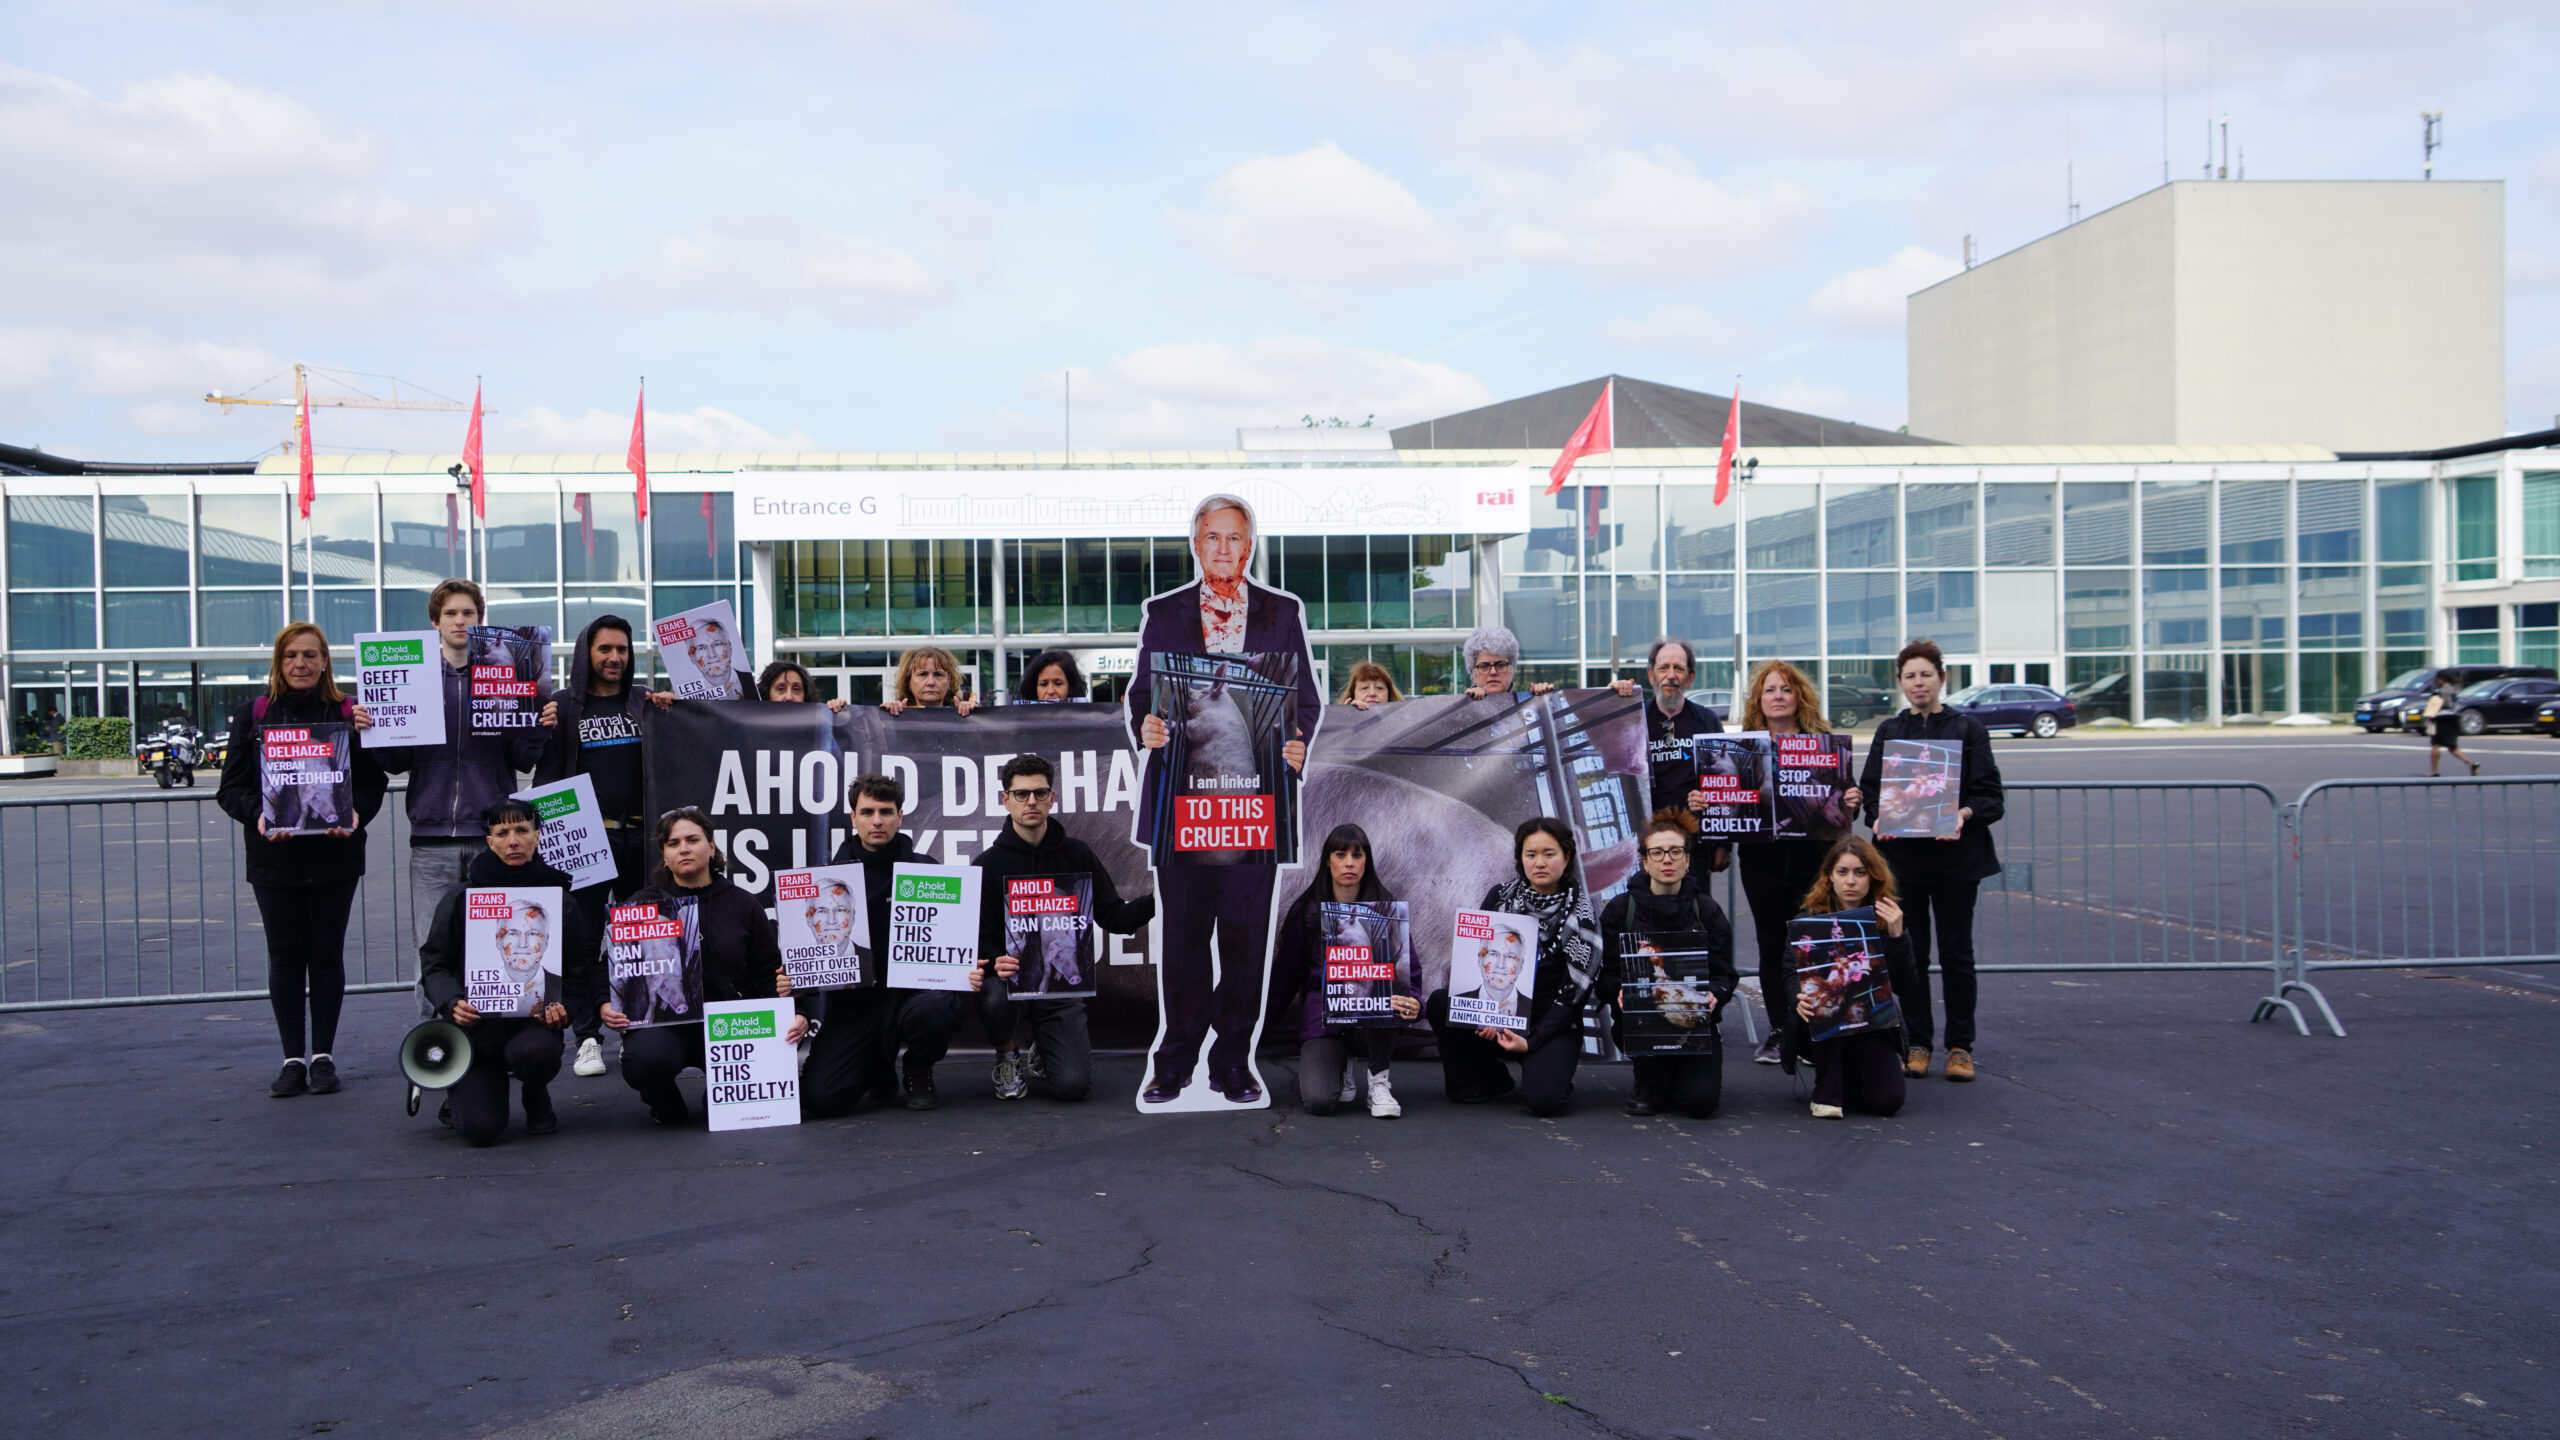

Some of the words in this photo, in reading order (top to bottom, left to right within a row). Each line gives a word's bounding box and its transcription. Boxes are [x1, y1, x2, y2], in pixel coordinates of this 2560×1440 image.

[1477, 488, 1514, 505] rai
[754, 496, 852, 515] Entrance
[860, 496, 876, 515] G
[658, 620, 685, 633] FRANS
[662, 630, 694, 644] MULLER
[382, 645, 408, 654] Ahold
[382, 653, 420, 662] Delhaize
[1098, 656, 1135, 669] Entra
[363, 670, 409, 685] GEEFT
[474, 668, 513, 679] AHOLD
[474, 683, 534, 695] DELHAIZE:
[679, 680, 702, 694] LETS
[364, 688, 398, 702] NIET
[382, 705, 416, 716] DIEREN
[472, 700, 496, 710] STOP
[499, 700, 519, 710] THIS
[379, 718, 391, 727] DE
[394, 717, 406, 726] VS
[472, 712, 539, 727] CRUELTY
[578, 712, 623, 730] animal
[266, 730, 308, 742] AHOLD
[1648, 738, 1693, 751] GUADAD
[1781, 740, 1816, 750] AHOLD
[268, 745, 331, 758] DELHAIZE:
[1651, 748, 1682, 762] nimal
[267, 761, 305, 772] VERBAN
[1781, 755, 1836, 766] DELHAIZE:
[268, 771, 344, 786] WREEDHEID
[1189, 775, 1194, 789] I
[1197, 777, 1218, 789] am
[1221, 774, 1260, 789] linked
[1702, 777, 1737, 787] AHOLD
[1779, 770, 1811, 782] STOP
[1703, 791, 1758, 802] DELHAIZE:
[1779, 785, 1832, 797] CRUELTY
[538, 797, 562, 810] Ahold
[538, 803, 575, 817] Delhaize
[1186, 798, 1212, 820] TO
[1218, 798, 1264, 819] THIS
[1703, 807, 1720, 815] HIS
[1722, 807, 1730, 815] IS
[540, 820, 565, 836] THIS
[1702, 818, 1761, 832] CRUELTY
[540, 835, 560, 850] HAT
[564, 827, 587, 842] YOU
[1180, 826, 1269, 848] CRUELTY
[541, 848, 565, 864] EAN
[567, 843, 581, 856] BY
[780, 874, 810, 886] FRANS
[918, 881, 946, 890] Ahold
[782, 887, 817, 899] MULLER
[1011, 881, 1052, 895] AHOLD
[472, 895, 504, 904] FRANS
[917, 890, 956, 900] Delhaize
[1012, 898, 1075, 913] DELHAIZE:
[472, 908, 509, 918] MULLER
[614, 906, 655, 922] AHOLD
[894, 905, 938, 923] STOP
[1010, 918, 1038, 933] BAN
[1042, 916, 1088, 931] CAGES
[1460, 914, 1488, 926] FRANS
[614, 922, 680, 940] DELHAIZE:
[894, 925, 932, 943] THIS
[1459, 926, 1492, 939] MULLER
[613, 945, 641, 960] BAN
[786, 945, 835, 959] CHOOSES
[892, 945, 973, 964] CRUELTY!
[1328, 948, 1368, 960] AHOLD
[614, 959, 675, 978] CRUELTY
[788, 960, 825, 973] PROFIT
[828, 957, 857, 970] OVER
[471, 970, 500, 981] LETS
[1329, 966, 1392, 978] DELHAIZE:
[790, 971, 856, 987] COMPASSION
[470, 984, 520, 996] ANIMALS
[1327, 984, 1343, 995] DIT
[1345, 984, 1354, 995] IS
[470, 999, 514, 1011] SUFFER
[1327, 997, 1393, 1012] WREEDHE
[1453, 998, 1482, 1010] LINKED
[1486, 1002, 1496, 1010] TO
[731, 1017, 759, 1026] Ahold
[1451, 1012, 1481, 1023] ANIMAL
[1485, 1014, 1524, 1028] CRUELTY!
[731, 1026, 772, 1036] Delhaize
[710, 1043, 754, 1062] STOP
[711, 1064, 750, 1082] THIS
[712, 1080, 794, 1103] CRUELTY!
